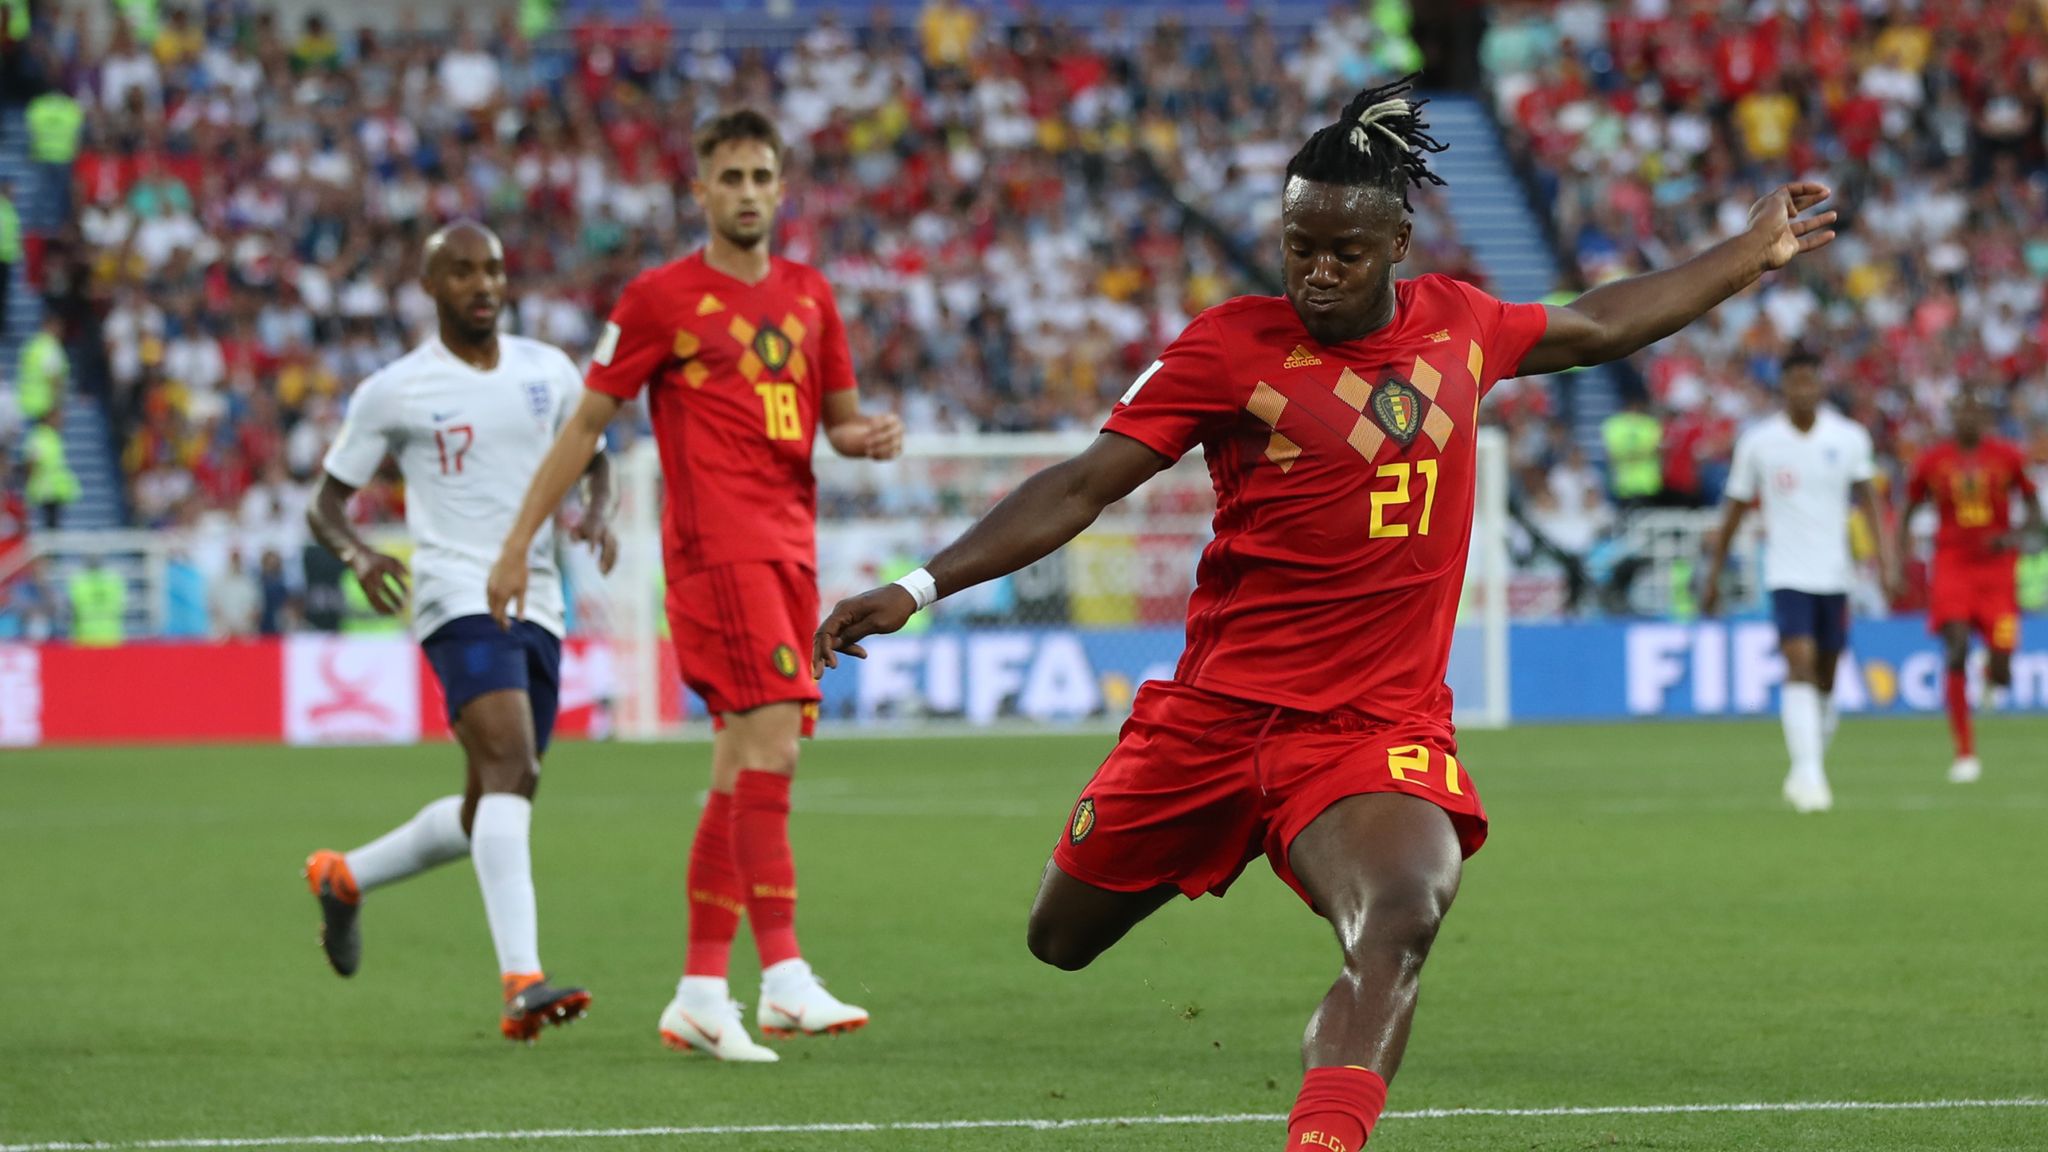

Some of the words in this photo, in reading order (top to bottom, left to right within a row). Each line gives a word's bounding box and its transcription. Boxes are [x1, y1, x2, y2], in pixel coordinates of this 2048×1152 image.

[754, 382, 802, 440] 18
[434, 423, 474, 475] 17
[1369, 459, 1438, 538] 21
[1386, 744, 1464, 796] 21
